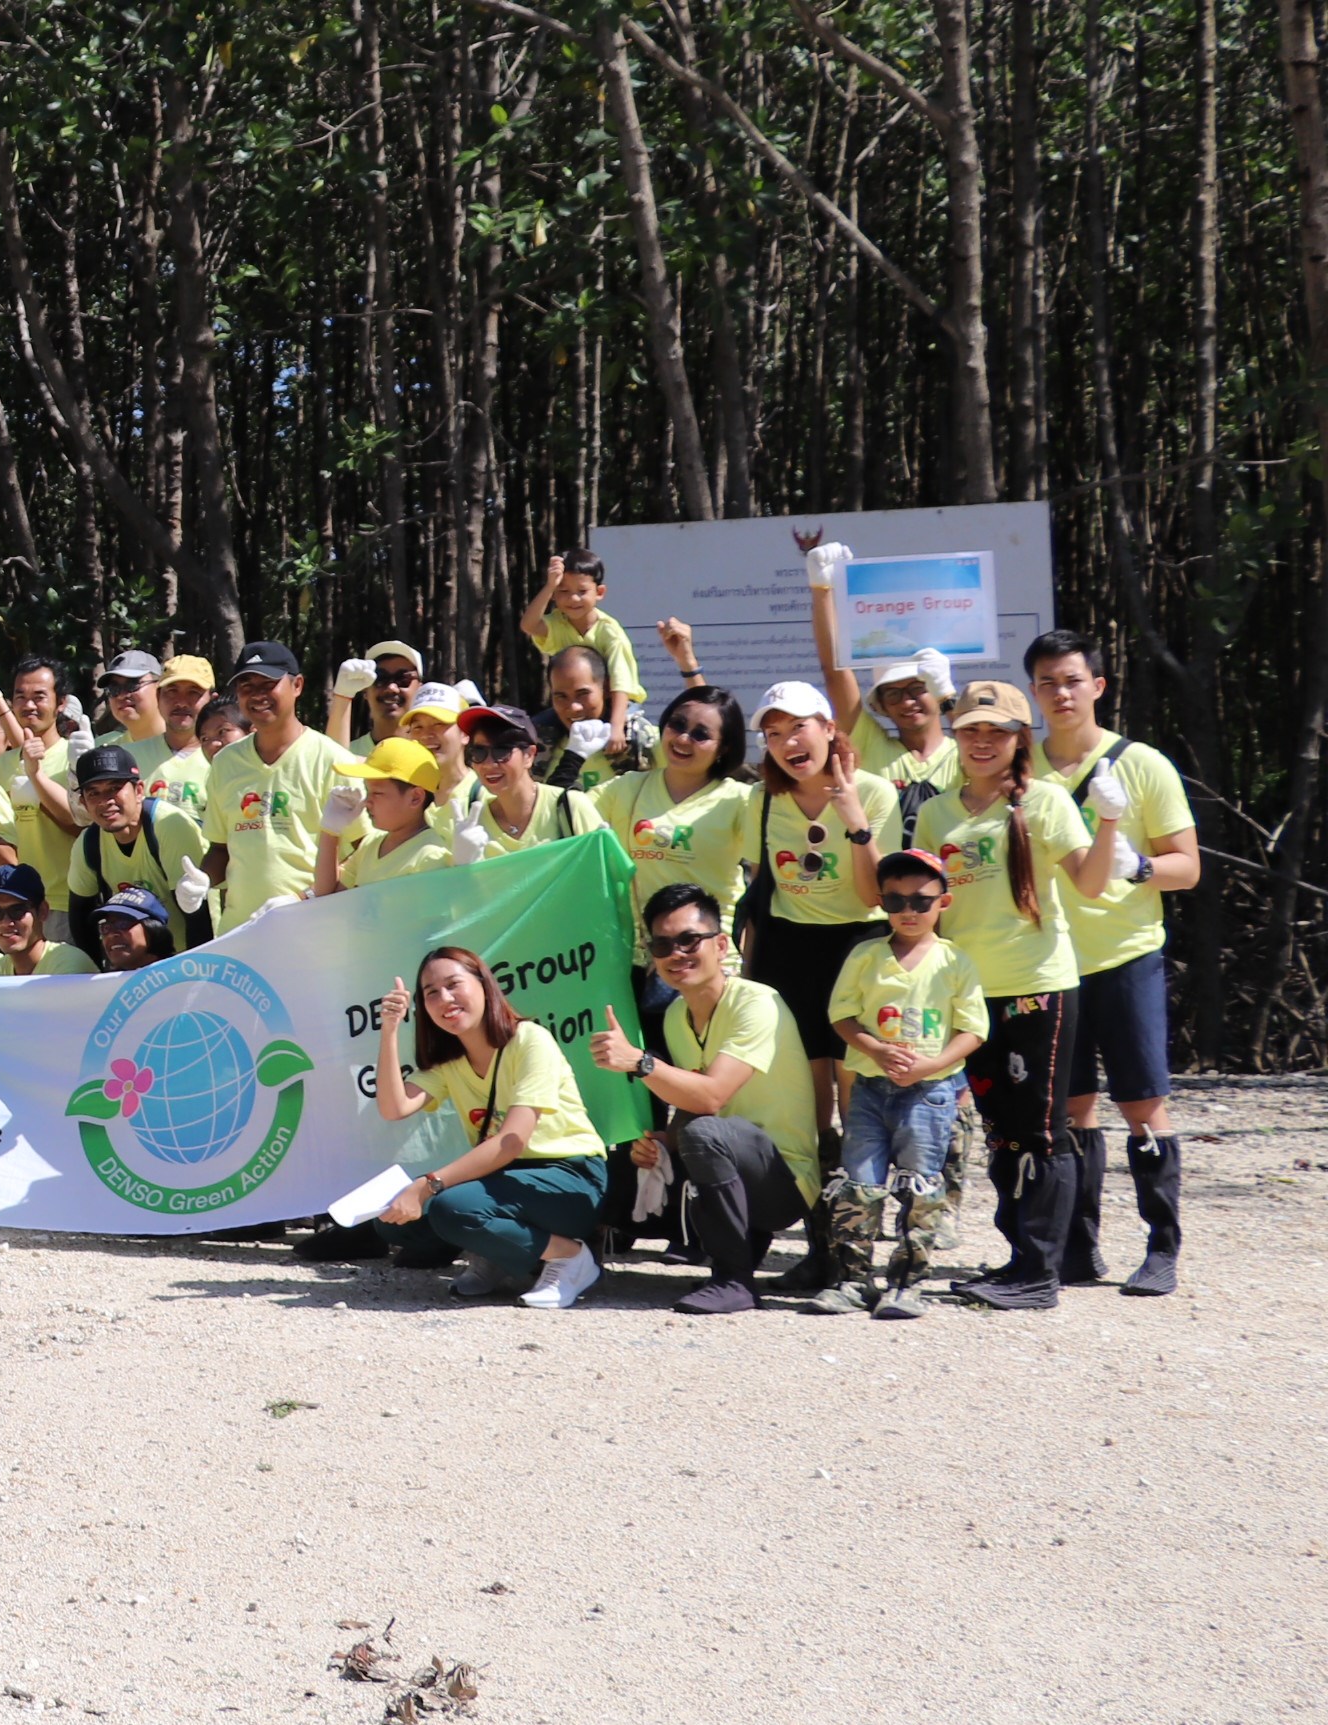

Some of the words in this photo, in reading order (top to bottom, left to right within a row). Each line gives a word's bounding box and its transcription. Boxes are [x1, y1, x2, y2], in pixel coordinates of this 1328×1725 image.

[855, 600, 916, 615] Orange
[923, 597, 973, 612] Group
[149, 779, 199, 804] CSR
[240, 792, 289, 818] CSR
[634, 819, 694, 850] CSR
[940, 836, 997, 873] CSR
[946, 873, 975, 888] ENSO
[490, 941, 596, 996] Group
[94, 1010, 123, 1048] Our
[119, 968, 170, 1011] Earth
[180, 958, 220, 978] Our
[220, 962, 271, 1013] Future
[877, 1005, 942, 1039] CSR
[97, 1156, 163, 1207] DENSO
[168, 1184, 235, 1211] Green
[240, 1126, 291, 1192] Action
